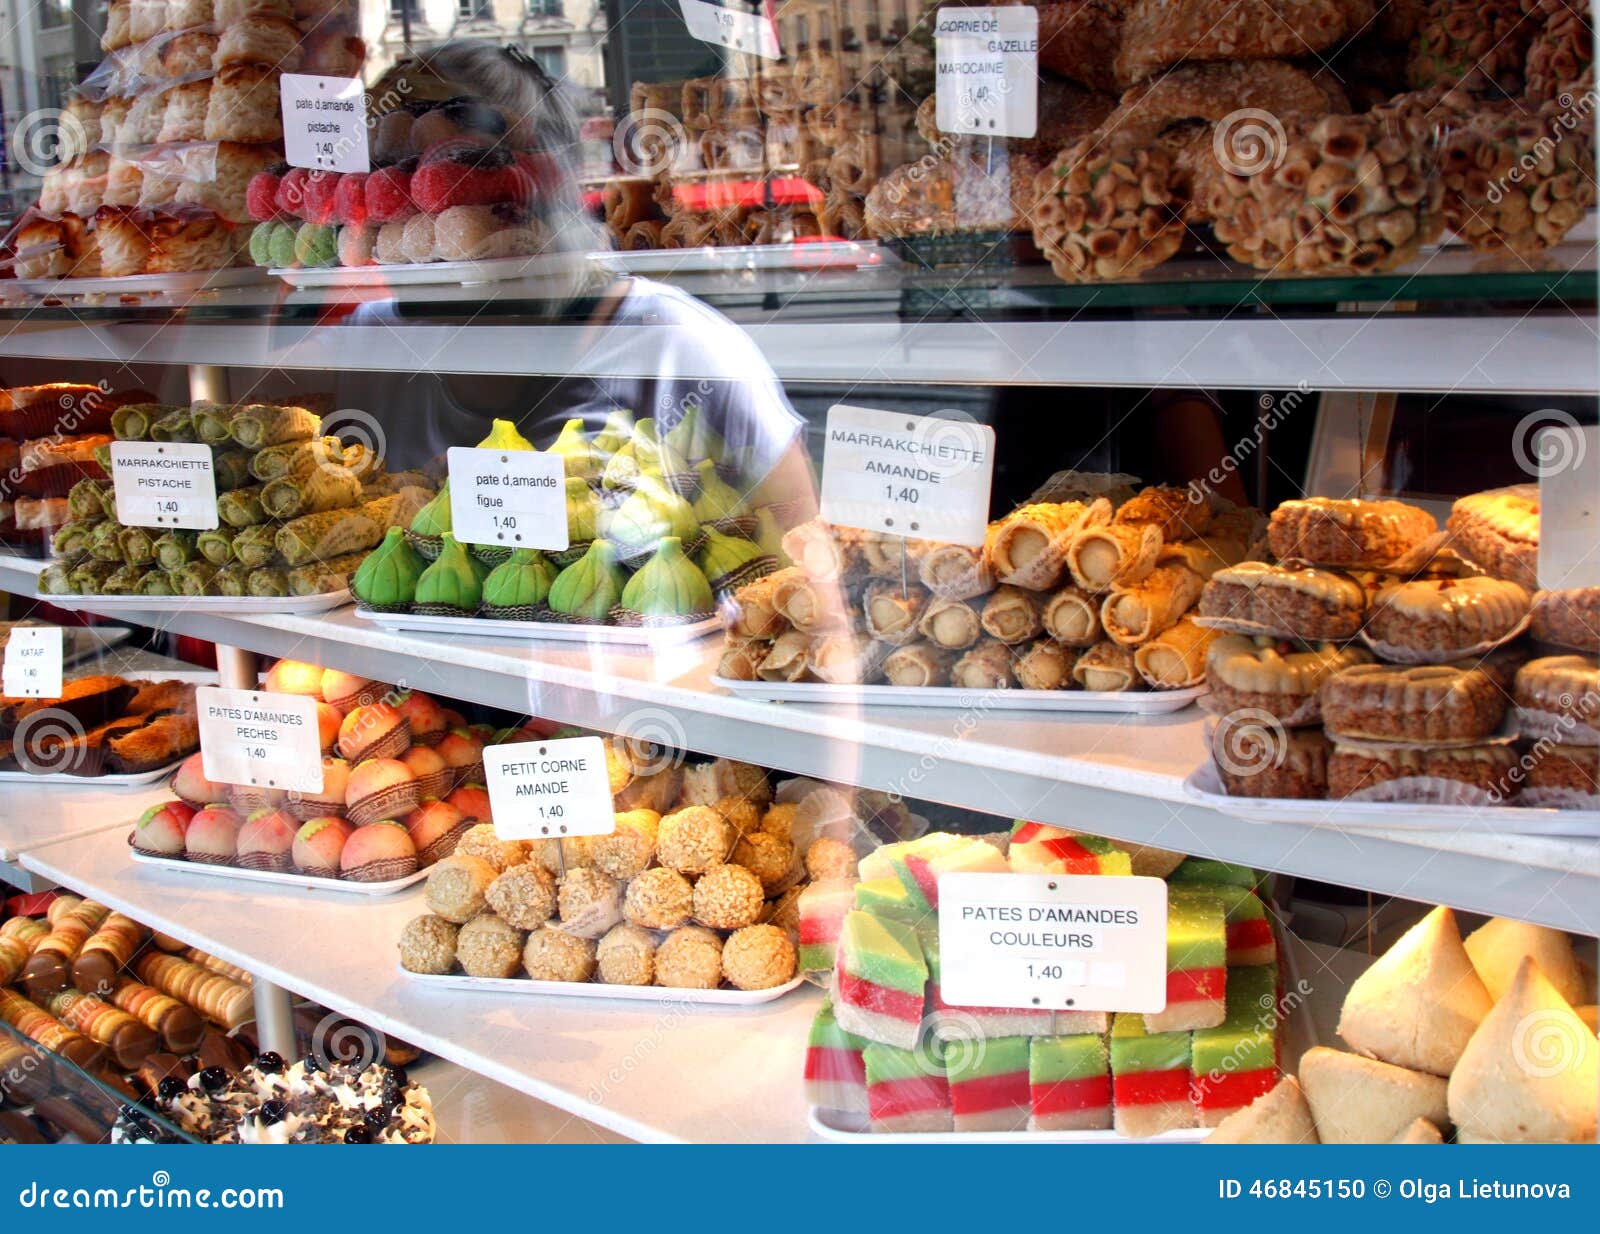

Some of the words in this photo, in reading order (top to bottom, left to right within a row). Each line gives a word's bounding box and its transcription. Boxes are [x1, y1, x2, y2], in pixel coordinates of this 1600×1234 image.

[939, 20, 980, 32] CORNE
[982, 20, 998, 32] DE
[987, 40, 1038, 53] GAZELLE
[938, 62, 1004, 75] MAROCAINE
[295, 99, 313, 110] pate
[307, 121, 341, 133] pistache
[315, 142, 334, 155] 1,40
[829, 429, 984, 465] MARRAKCHIETTE
[117, 458, 210, 470] MARRAKCHIETTE
[865, 460, 941, 484] AMANDE
[137, 478, 192, 489] PISTACHE
[476, 474, 499, 487] pate
[886, 484, 919, 504] 1,40
[157, 501, 179, 513] 1,40
[476, 494, 504, 508] figue
[493, 516, 517, 529] 1,40
[208, 706, 242, 720] PATES
[243, 710, 303, 726] D'AMANDES
[236, 727, 278, 741] PECHES
[246, 746, 266, 759] 1,40
[501, 761, 538, 776] PETIT
[540, 758, 588, 774] CORNE
[515, 781, 570, 796] AMANDE
[538, 804, 564, 820] 1,40
[962, 906, 1023, 922] PATES
[1028, 908, 1139, 925] D'AMANDES
[989, 931, 1094, 949] COULEURS
[1027, 964, 1063, 980] 1,40
